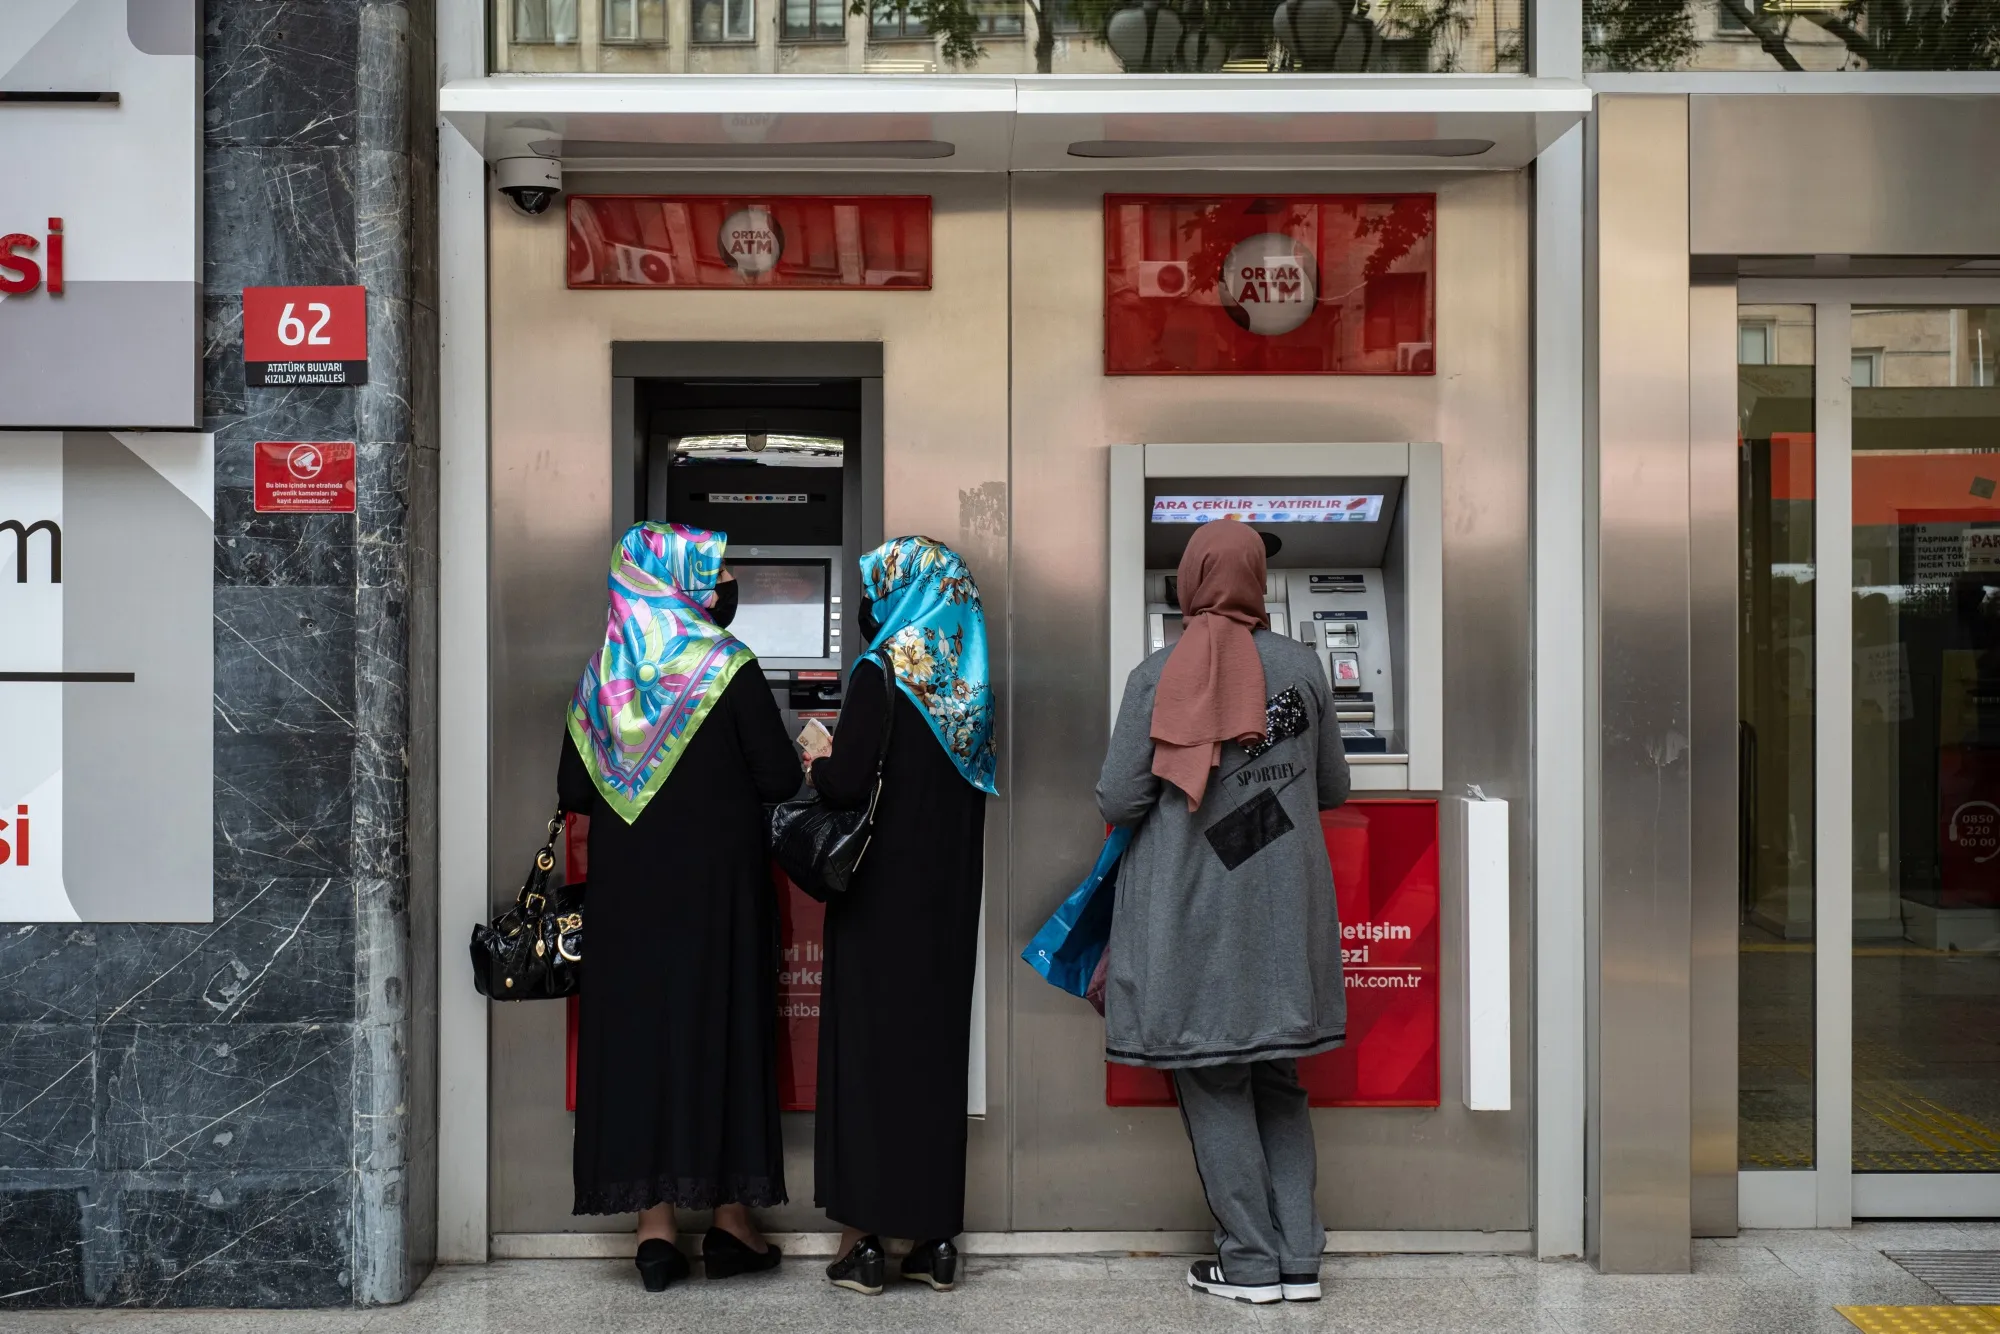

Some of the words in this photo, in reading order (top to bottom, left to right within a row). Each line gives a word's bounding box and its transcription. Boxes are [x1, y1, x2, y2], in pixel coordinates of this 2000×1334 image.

[732, 230, 771, 239] ORTAK
[731, 240, 772, 254] ATM
[1241, 267, 1300, 280] ORTAK
[1238, 282, 1302, 303] ATM
[277, 303, 331, 346] 62
[267, 362, 305, 373] ATATÜRK
[307, 363, 342, 372] BULVARI
[265, 374, 297, 384] KIZILAY
[298, 372, 346, 383] MAHALLESİ
[272, 490, 298, 498] güvenlik
[1192, 498, 1253, 511] ÇEKİLİR
[1268, 500, 1342, 509] YATIRILIR
[1962, 814, 1994, 823] 0850
[1966, 826, 1990, 835] 220
[1960, 838, 1977, 847] 00
[1980, 838, 1996, 847] 00
[1344, 973, 1421, 988] nk.com.tr
